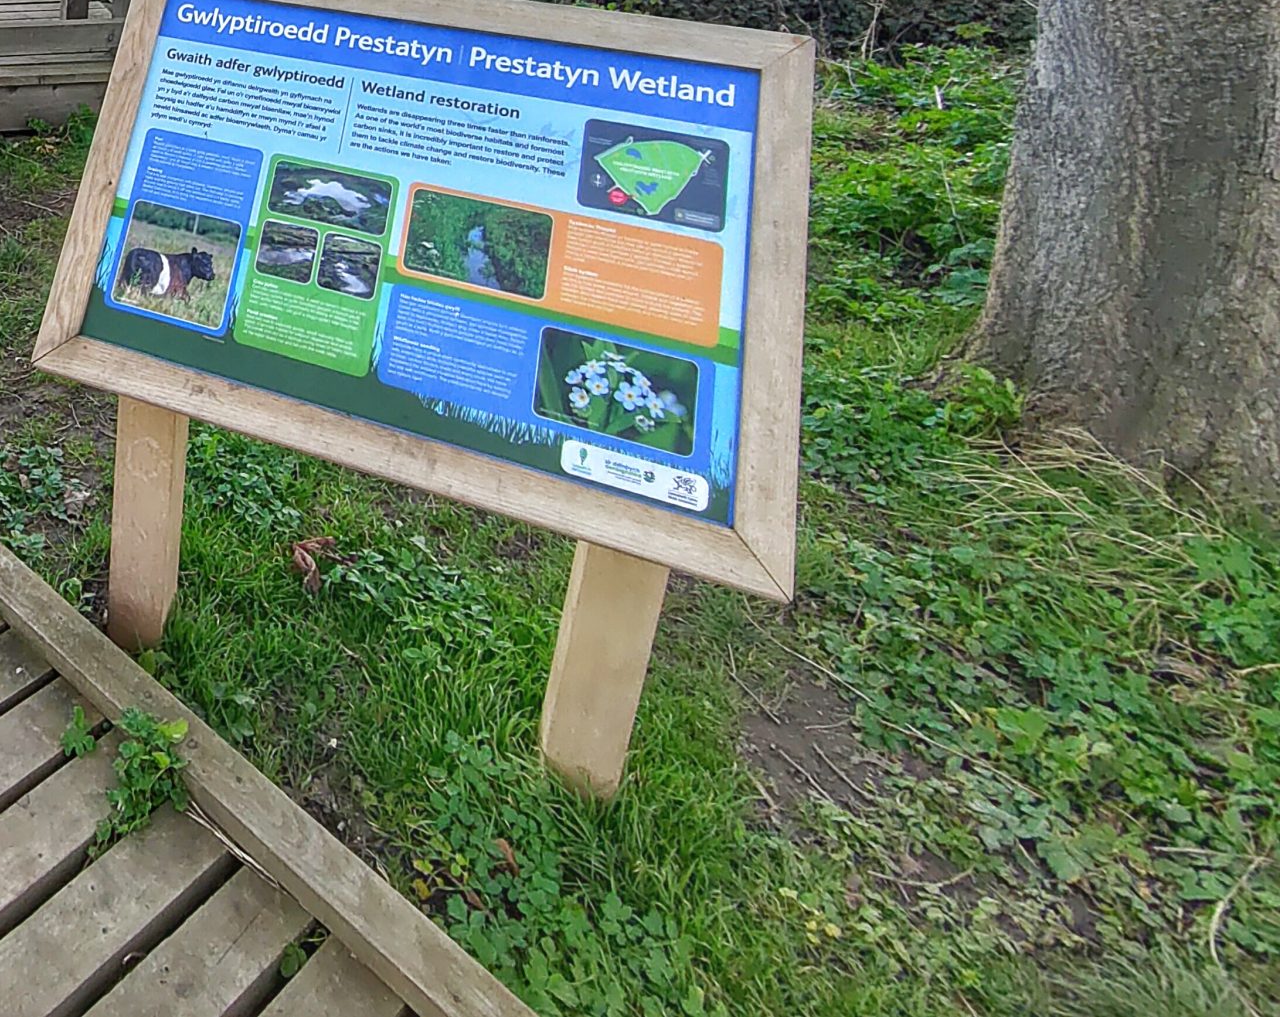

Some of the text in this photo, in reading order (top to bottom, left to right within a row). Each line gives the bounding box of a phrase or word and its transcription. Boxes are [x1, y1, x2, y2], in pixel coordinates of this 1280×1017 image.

[176, 2, 452, 65] Gwlyptiroedd Prestatyn
[166, 47, 345, 89] Gwaith adfer gwlyptiroedd
[468, 45, 735, 107] Prestatyn Wetland
[361, 79, 520, 119] Wetland restoration
[356, 102, 388, 114] Wetlands
[446, 118, 466, 128] three
[466, 122, 487, 132] times
[487, 125, 509, 135] faster
[509, 129, 527, 139] than
[399, 121, 425, 131] world's
[425, 125, 445, 134] most
[483, 135, 513, 147] habitats
[529, 143, 564, 156] foremost
[350, 130, 369, 140] them
[377, 135, 398, 145] tackle
[398, 139, 425, 150] climate
[425, 144, 452, 156] change
[467, 153, 494, 163] restore
[542, 166, 566, 177] These
[352, 122, 377, 132] carbon
[377, 126, 397, 136] sinks,
[492, 147, 520, 158] restore
[535, 156, 564, 167] protect
[373, 145, 399, 155] actions
[410, 151, 429, 161] have
[429, 155, 452, 166] taken:
